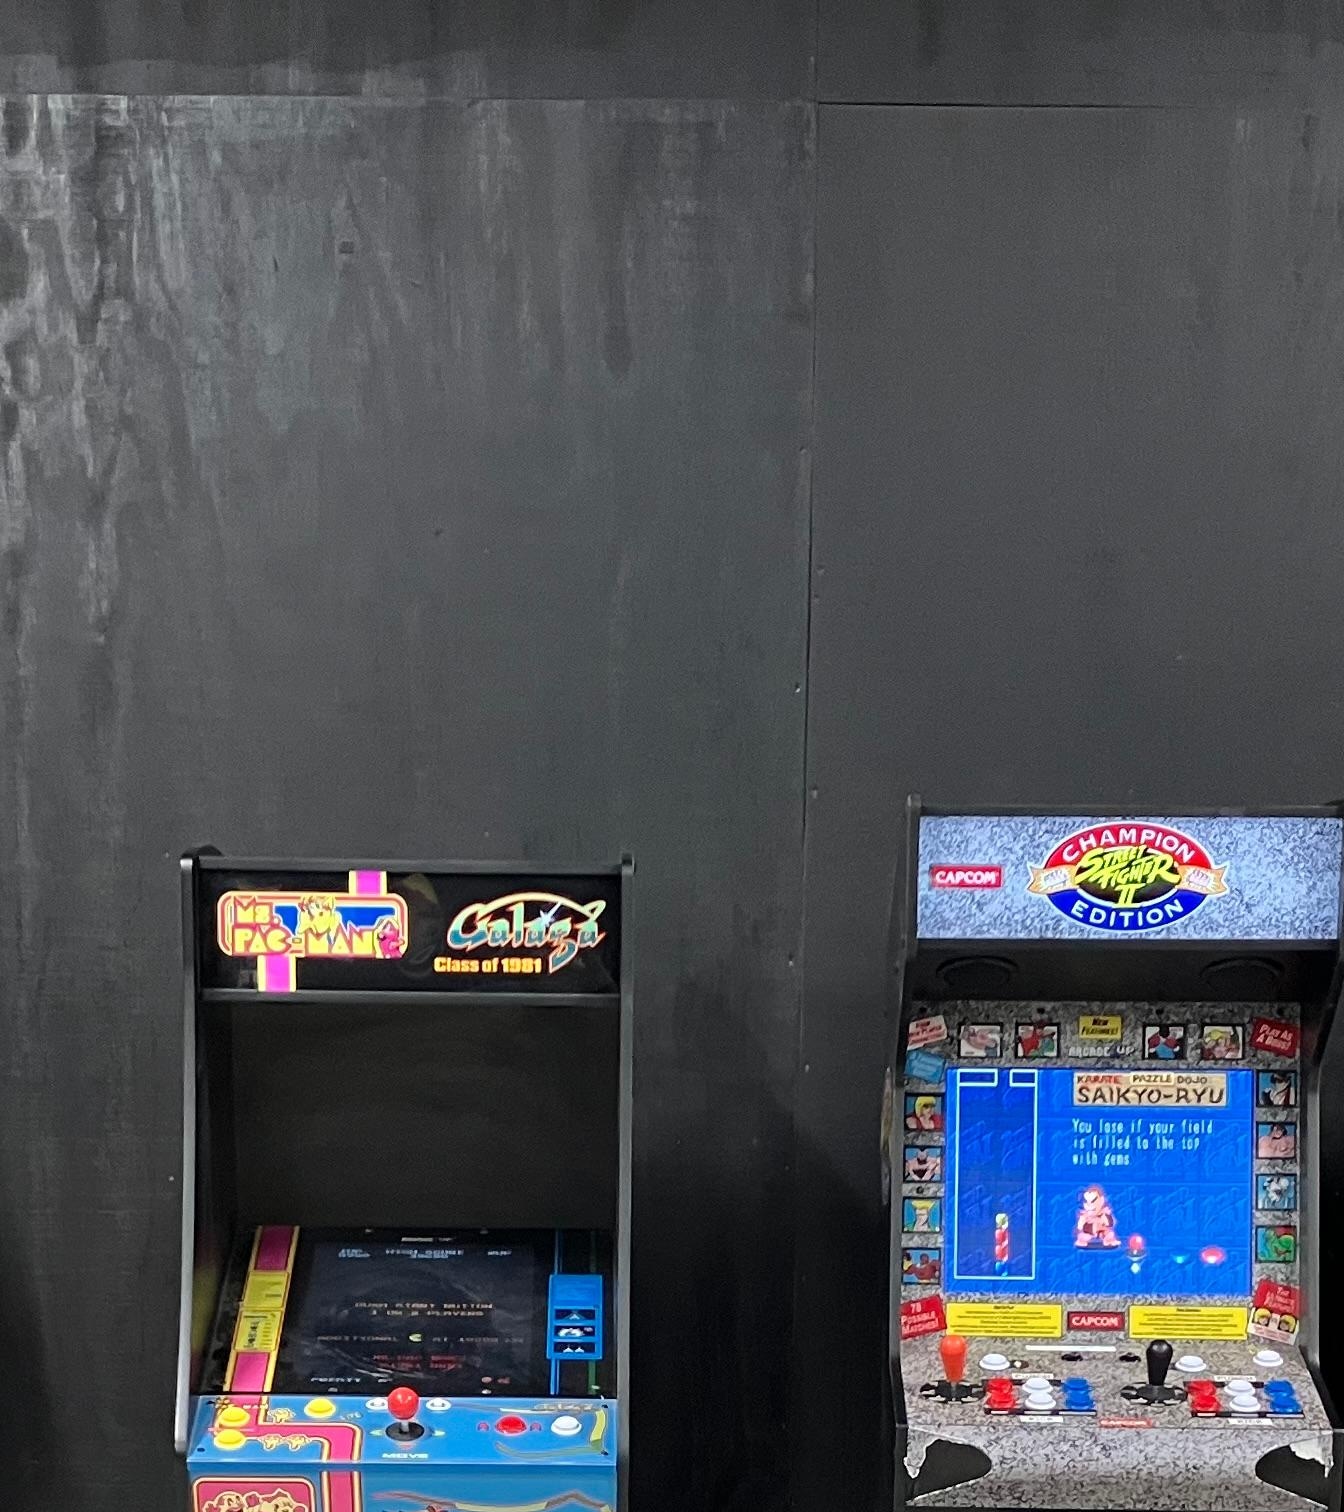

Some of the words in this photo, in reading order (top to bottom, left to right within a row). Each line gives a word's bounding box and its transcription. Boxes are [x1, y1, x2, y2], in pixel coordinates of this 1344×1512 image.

[1061, 826, 1197, 865] CHAMPION
[934, 869, 997, 885] CAPCOM
[1094, 853, 1182, 890] FIGHTER
[1069, 898, 1185, 929] EDITION
[447, 891, 607, 973] Galaga
[231, 926, 377, 958] PAC-MAN
[434, 956, 479, 974] Class
[481, 956, 499, 973] of
[501, 956, 543, 974] 1981
[1077, 1074, 1122, 1084] KARATE
[1177, 1075, 1207, 1084] DOJO
[1077, 1085, 1225, 1105] SAIKYO-RYU
[1072, 1118, 1092, 1133] You
[1099, 1118, 1124, 1133] lose
[1131, 1118, 1142, 1133] if
[1149, 1122, 1174, 1135] your
[1182, 1118, 1213, 1134] field
[1073, 1136, 1085, 1149] is
[1093, 1134, 1130, 1150] filled
[1137, 1136, 1149, 1150] to
[1156, 1136, 1174, 1150] the
[1182, 1136, 1200, 1150] top
[1072, 1151, 1098, 1166] with
[1104, 1153, 1130, 1167] gems
[1071, 1315, 1119, 1327] CAPCOM
